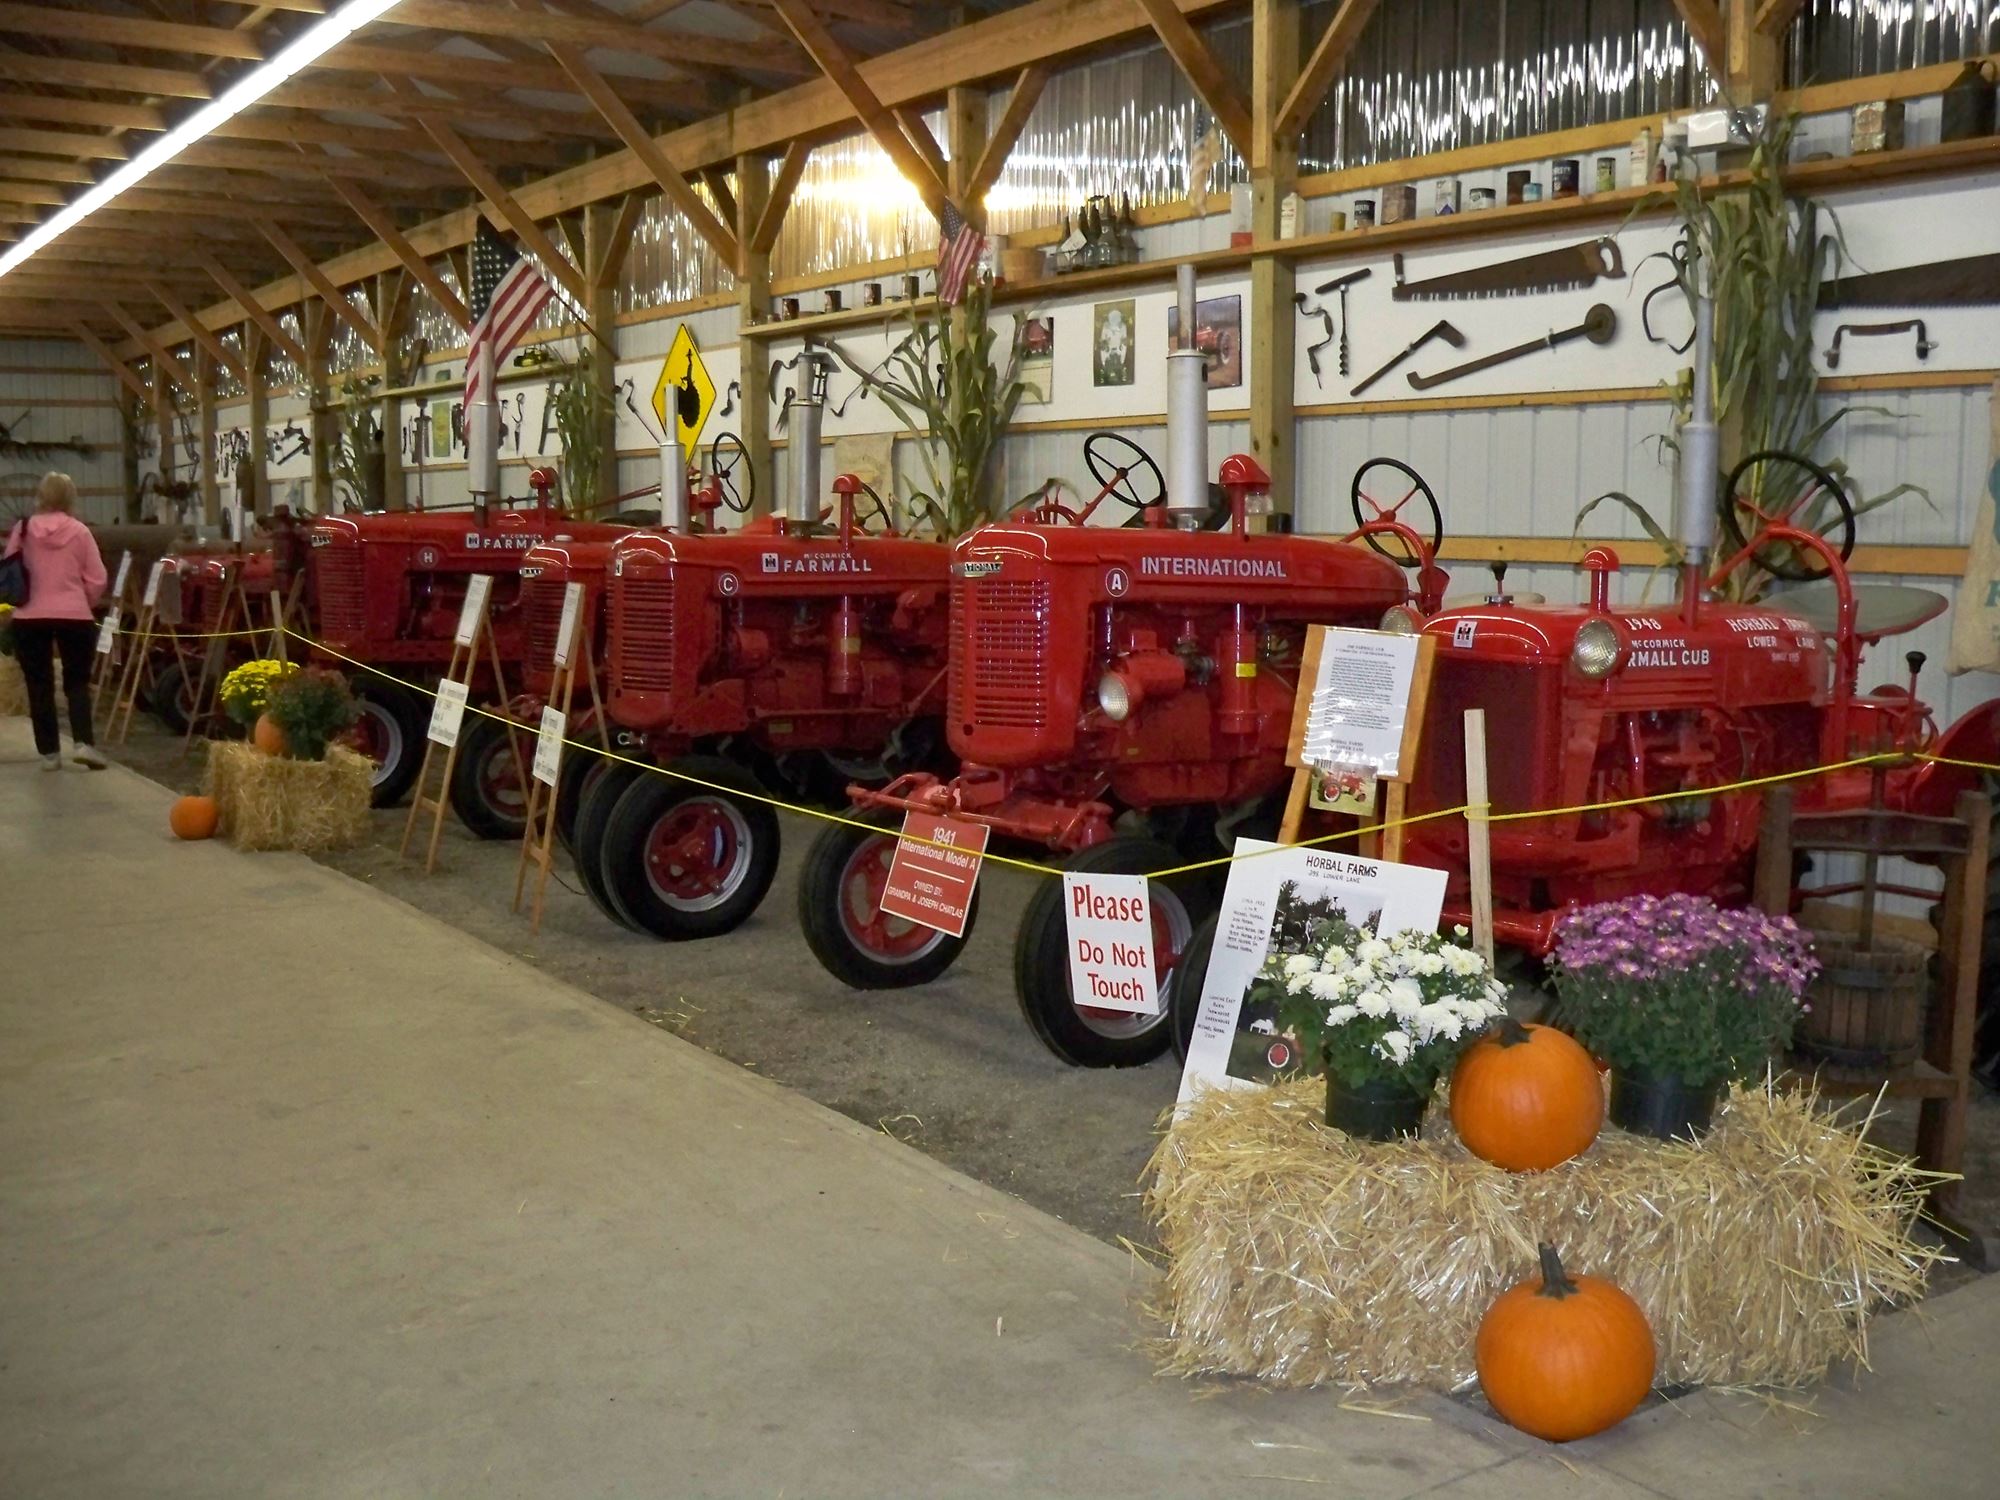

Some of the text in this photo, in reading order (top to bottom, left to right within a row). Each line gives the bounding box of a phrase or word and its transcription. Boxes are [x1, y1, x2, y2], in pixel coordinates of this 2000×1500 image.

[483, 539, 540, 549] FARMA
[783, 559, 872, 573] FARMALL
[1142, 556, 1287, 578] INTERNATIONAL
[723, 577, 733, 591] C
[1112, 573, 1122, 591] A
[1624, 618, 1662, 631] 1948
[1725, 617, 1780, 632] HORBAL
[1746, 635, 1777, 648] LOWER
[1628, 649, 1710, 667] RMALL CUB
[933, 826, 957, 847] 1941
[900, 838, 976, 871] International Model A
[1306, 855, 1378, 878] HORBAL FARMS
[917, 895, 939, 910] JOSEPH
[1072, 885, 1144, 922] Please
[1078, 939, 1147, 968] Do Not
[1087, 973, 1144, 1002] Touch
